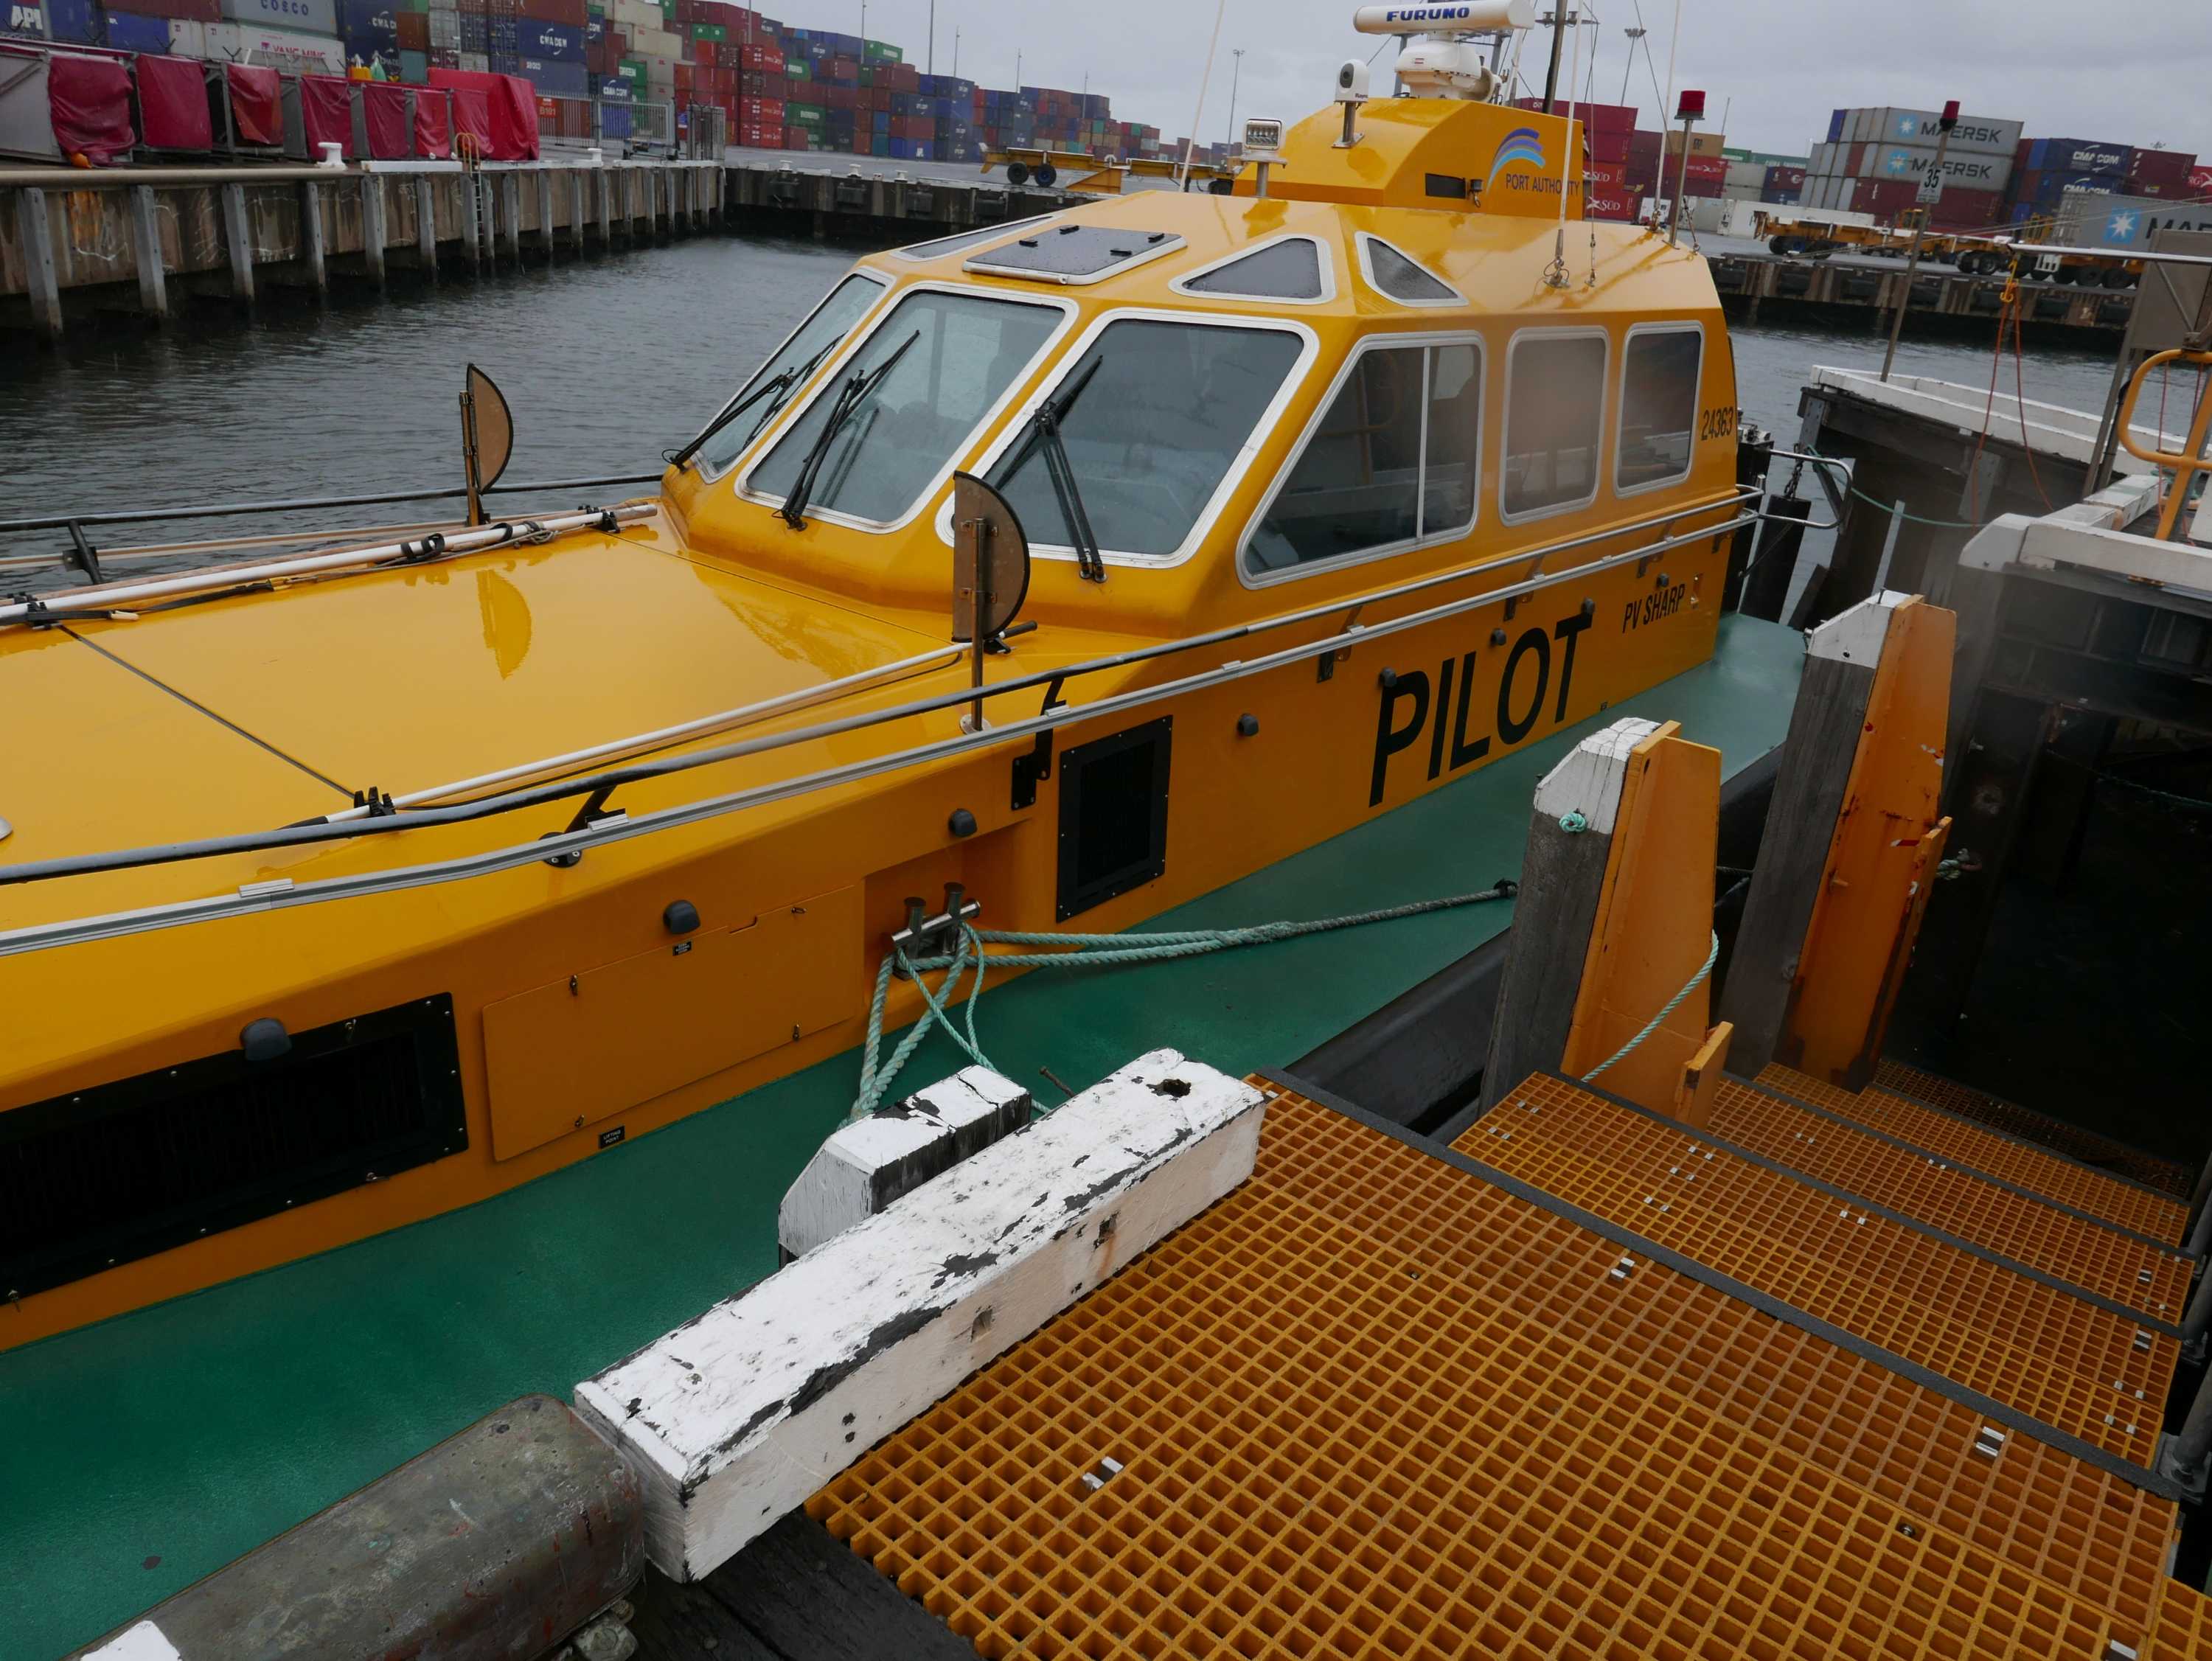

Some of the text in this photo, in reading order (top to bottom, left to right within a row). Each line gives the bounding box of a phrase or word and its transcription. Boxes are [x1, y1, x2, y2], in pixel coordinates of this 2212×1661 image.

[260, 0, 309, 15] COSCO
[1386, 7, 1470, 22] FURUNO
[1506, 173, 1580, 195] PORT AUTHOITY
[1924, 169, 1941, 188] 35
[1622, 583, 1686, 634] PV SHARP
[1368, 611, 1593, 808] PILOT
